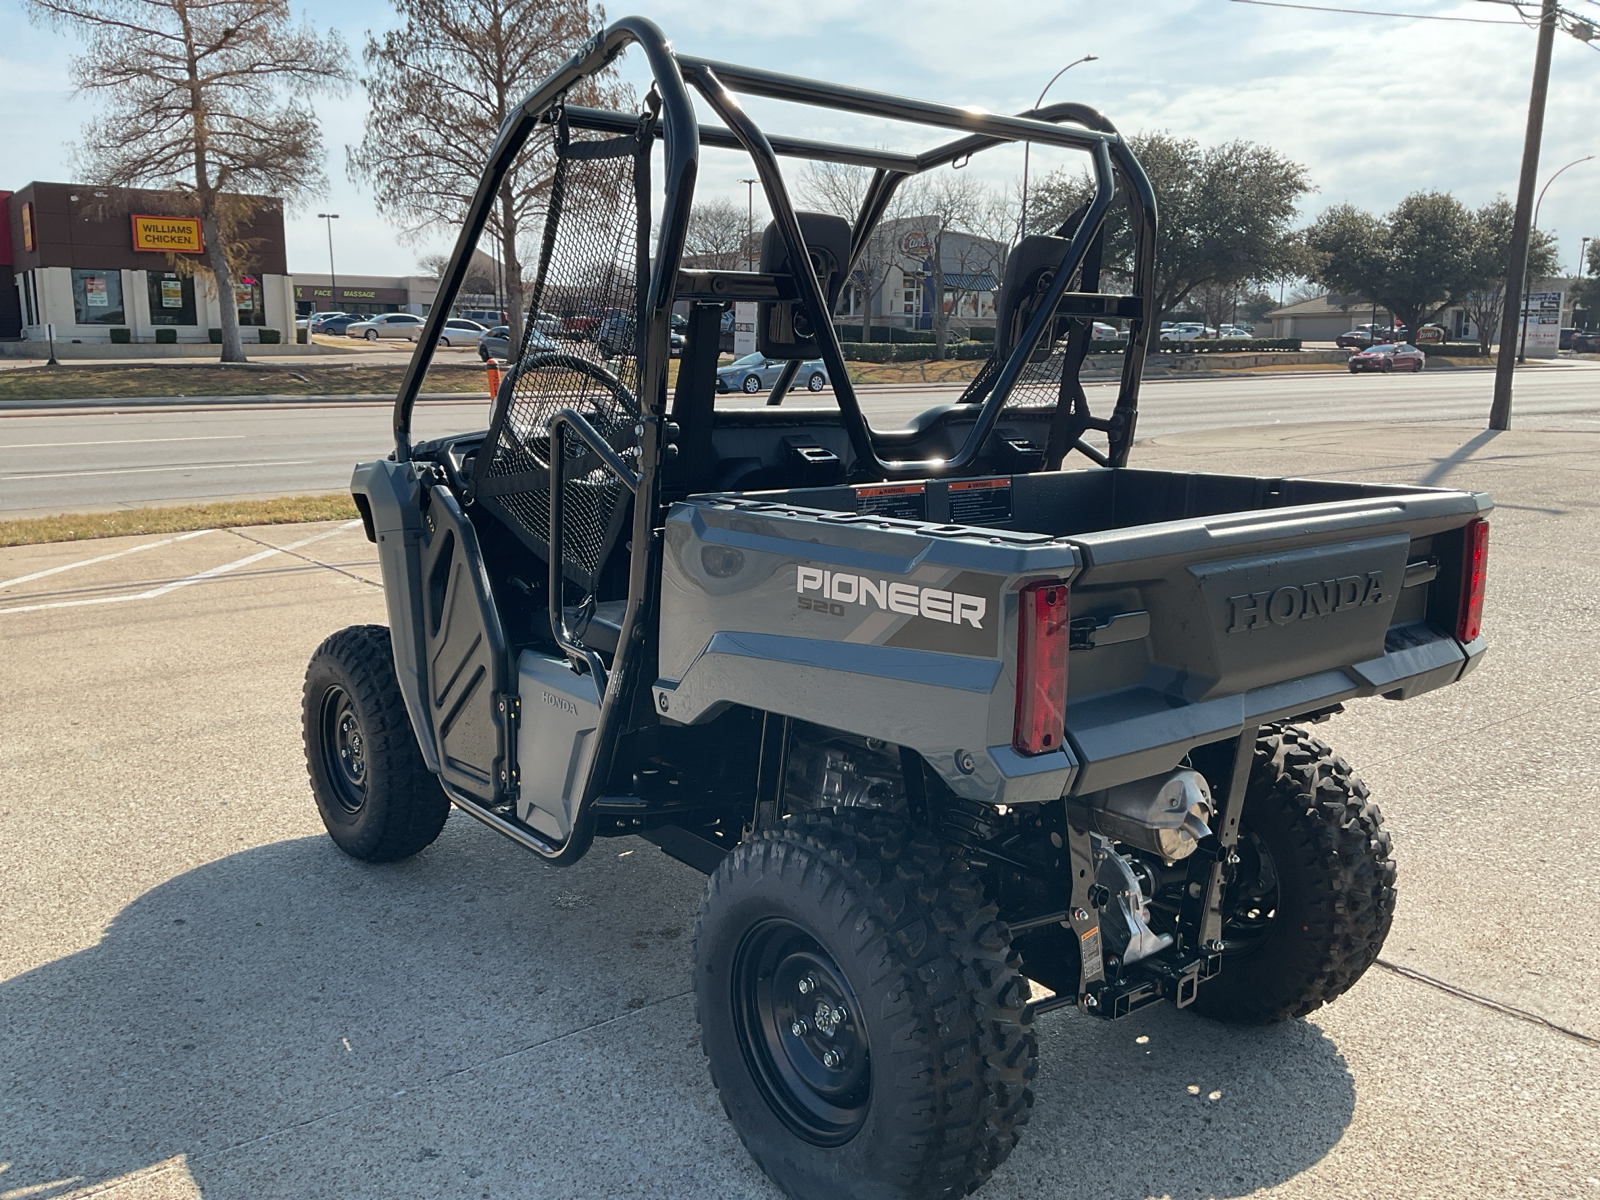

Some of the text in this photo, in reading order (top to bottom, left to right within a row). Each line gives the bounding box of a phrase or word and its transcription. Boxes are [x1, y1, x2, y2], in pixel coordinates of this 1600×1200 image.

[142, 224, 193, 234] WILLIAMS
[144, 235, 191, 244] CHICKEN
[343, 290, 375, 298] MASSAGE
[797, 565, 986, 629] PIONEER
[797, 596, 845, 617] 520
[1227, 570, 1392, 633] HONDA
[542, 691, 578, 715] HONDA
